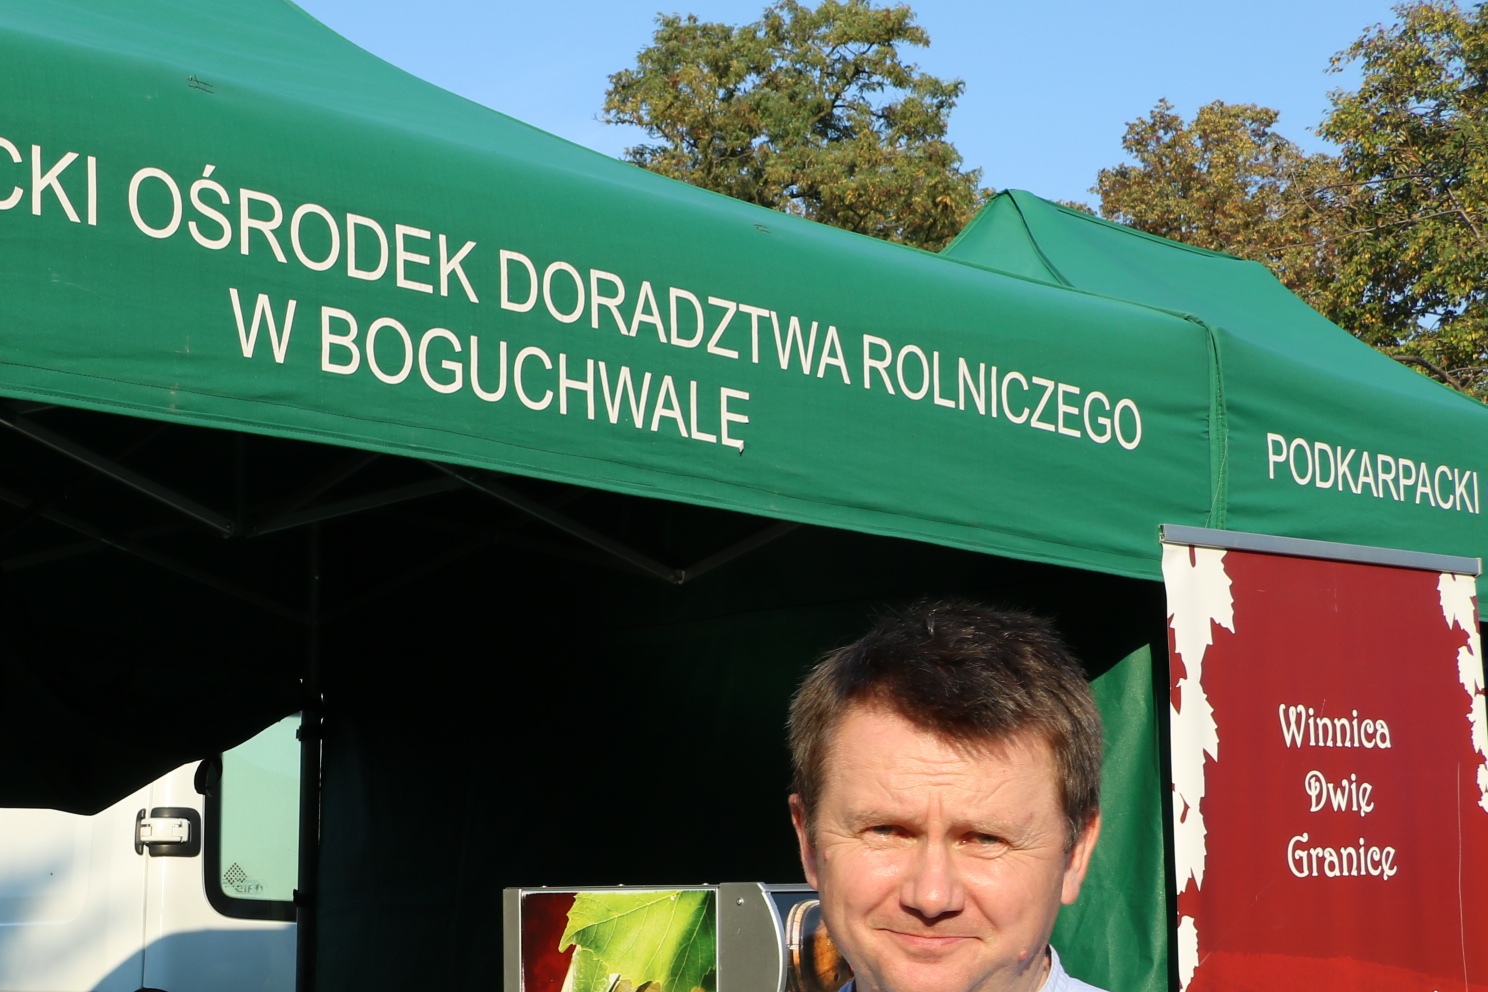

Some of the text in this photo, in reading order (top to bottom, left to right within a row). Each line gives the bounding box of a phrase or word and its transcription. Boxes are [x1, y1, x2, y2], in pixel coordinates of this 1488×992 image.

[127, 163, 479, 304] OŚRODEK
[499, 249, 852, 387] DORADZTWA
[862, 334, 1143, 451] ROLNICZEGO
[229, 287, 296, 365] W
[1267, 432, 1479, 515] PODKARPACKI
[1278, 703, 1392, 749] Winnica
